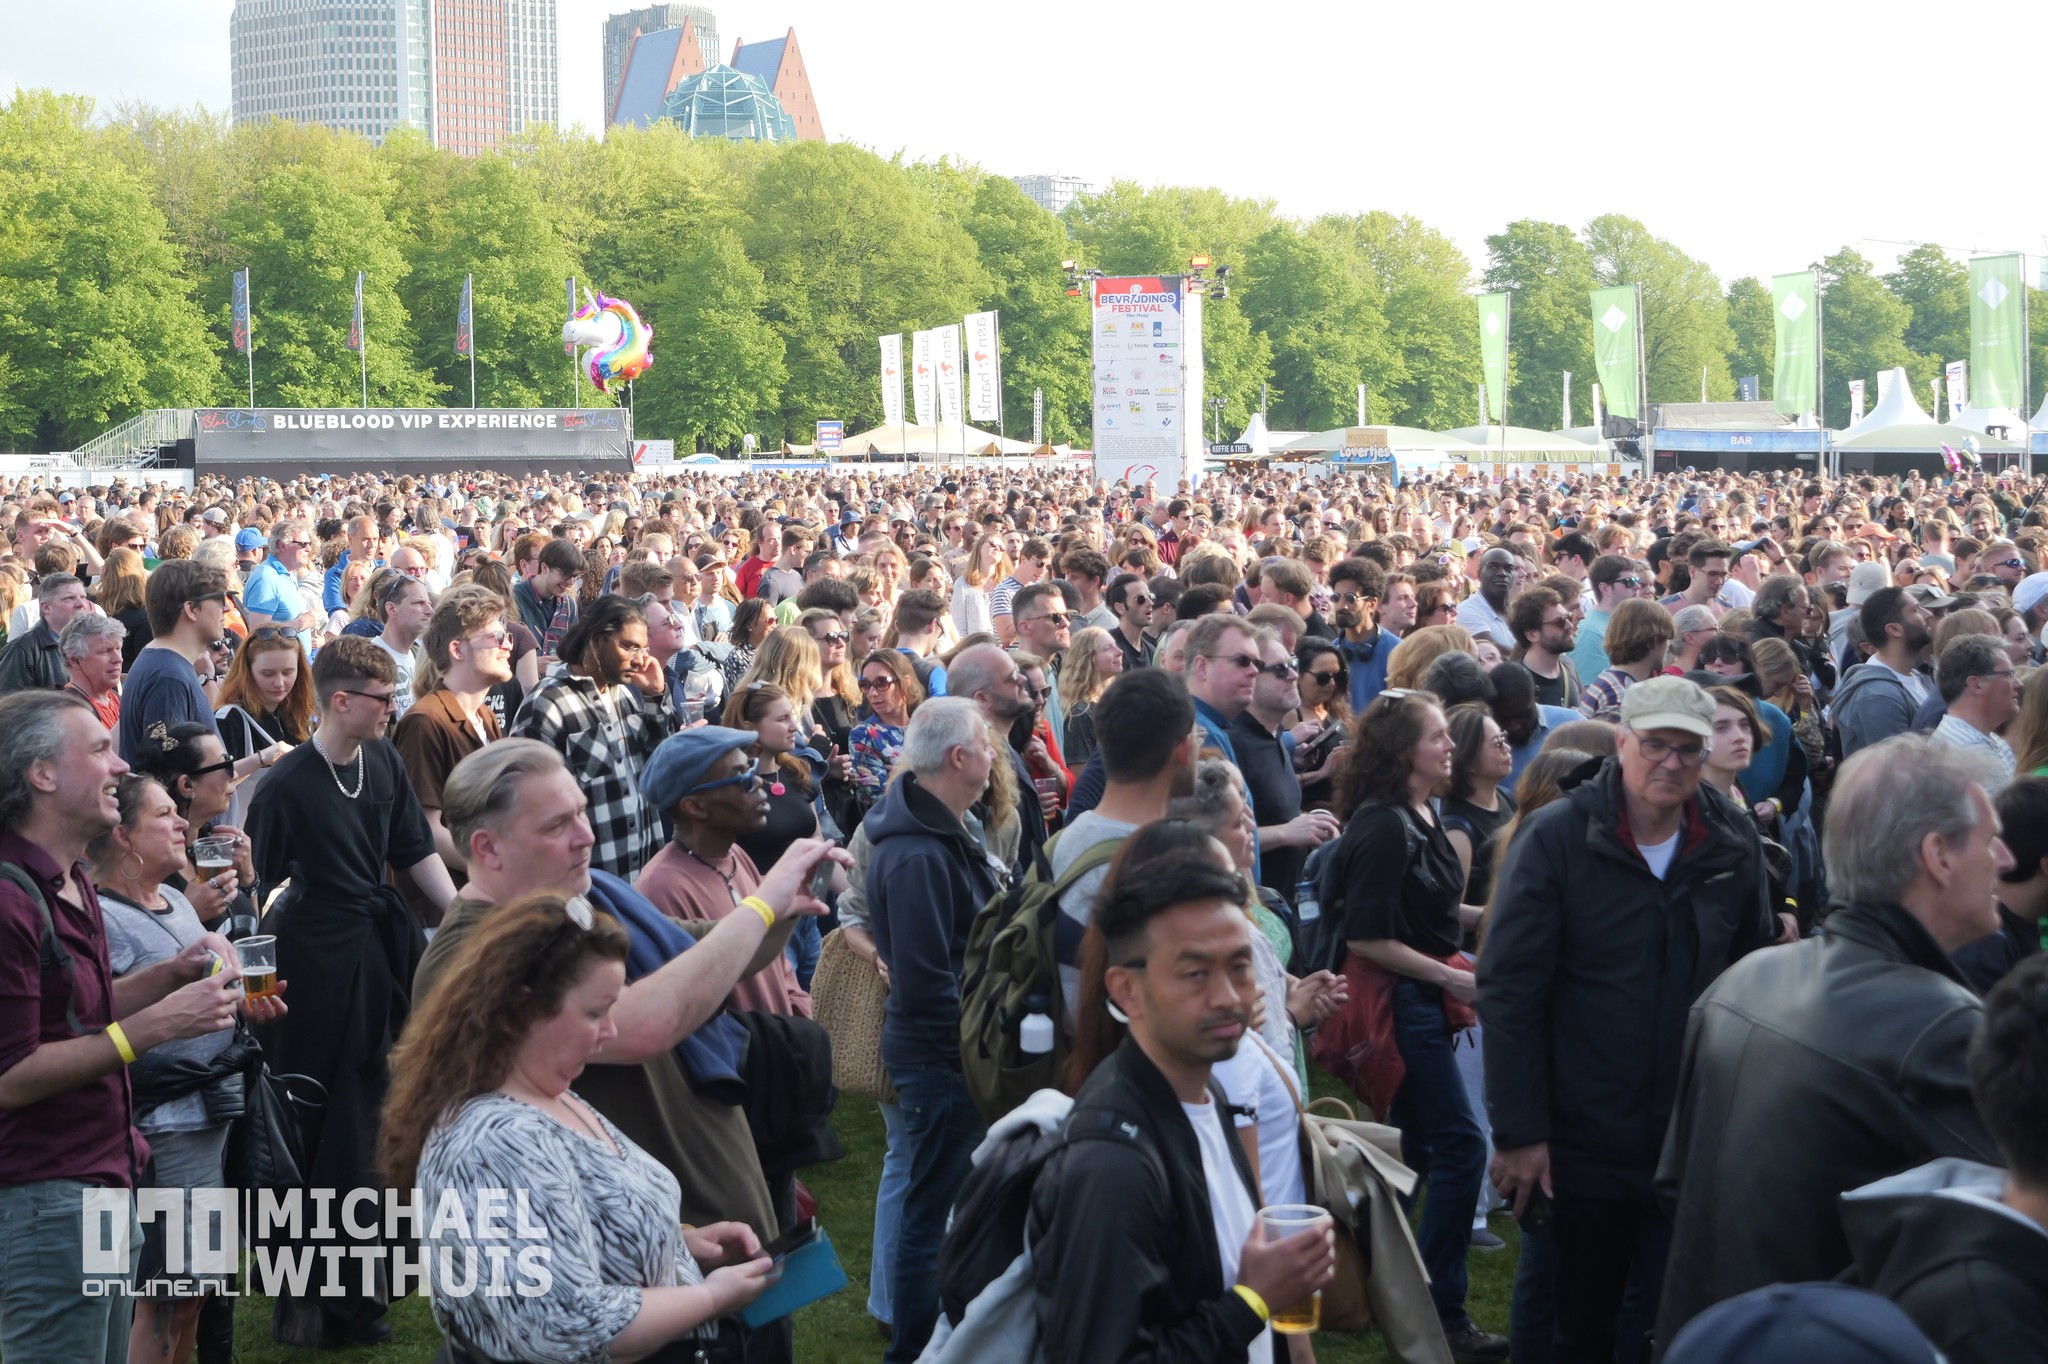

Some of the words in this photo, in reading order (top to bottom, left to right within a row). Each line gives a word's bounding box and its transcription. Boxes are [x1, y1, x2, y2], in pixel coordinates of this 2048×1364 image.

[1101, 294, 1175, 304] BEVRIJDINGS
[1112, 304, 1164, 312] FESTIVAL
[273, 414, 394, 429] BLUEBLOOD
[401, 414, 433, 429] VIP
[439, 414, 557, 429] EXPERIENCE
[1730, 436, 1752, 445] BAR
[1212, 444, 1230, 453] KOFFIE
[1235, 444, 1247, 452] THEE
[1339, 444, 1391, 461] Lovertjes
